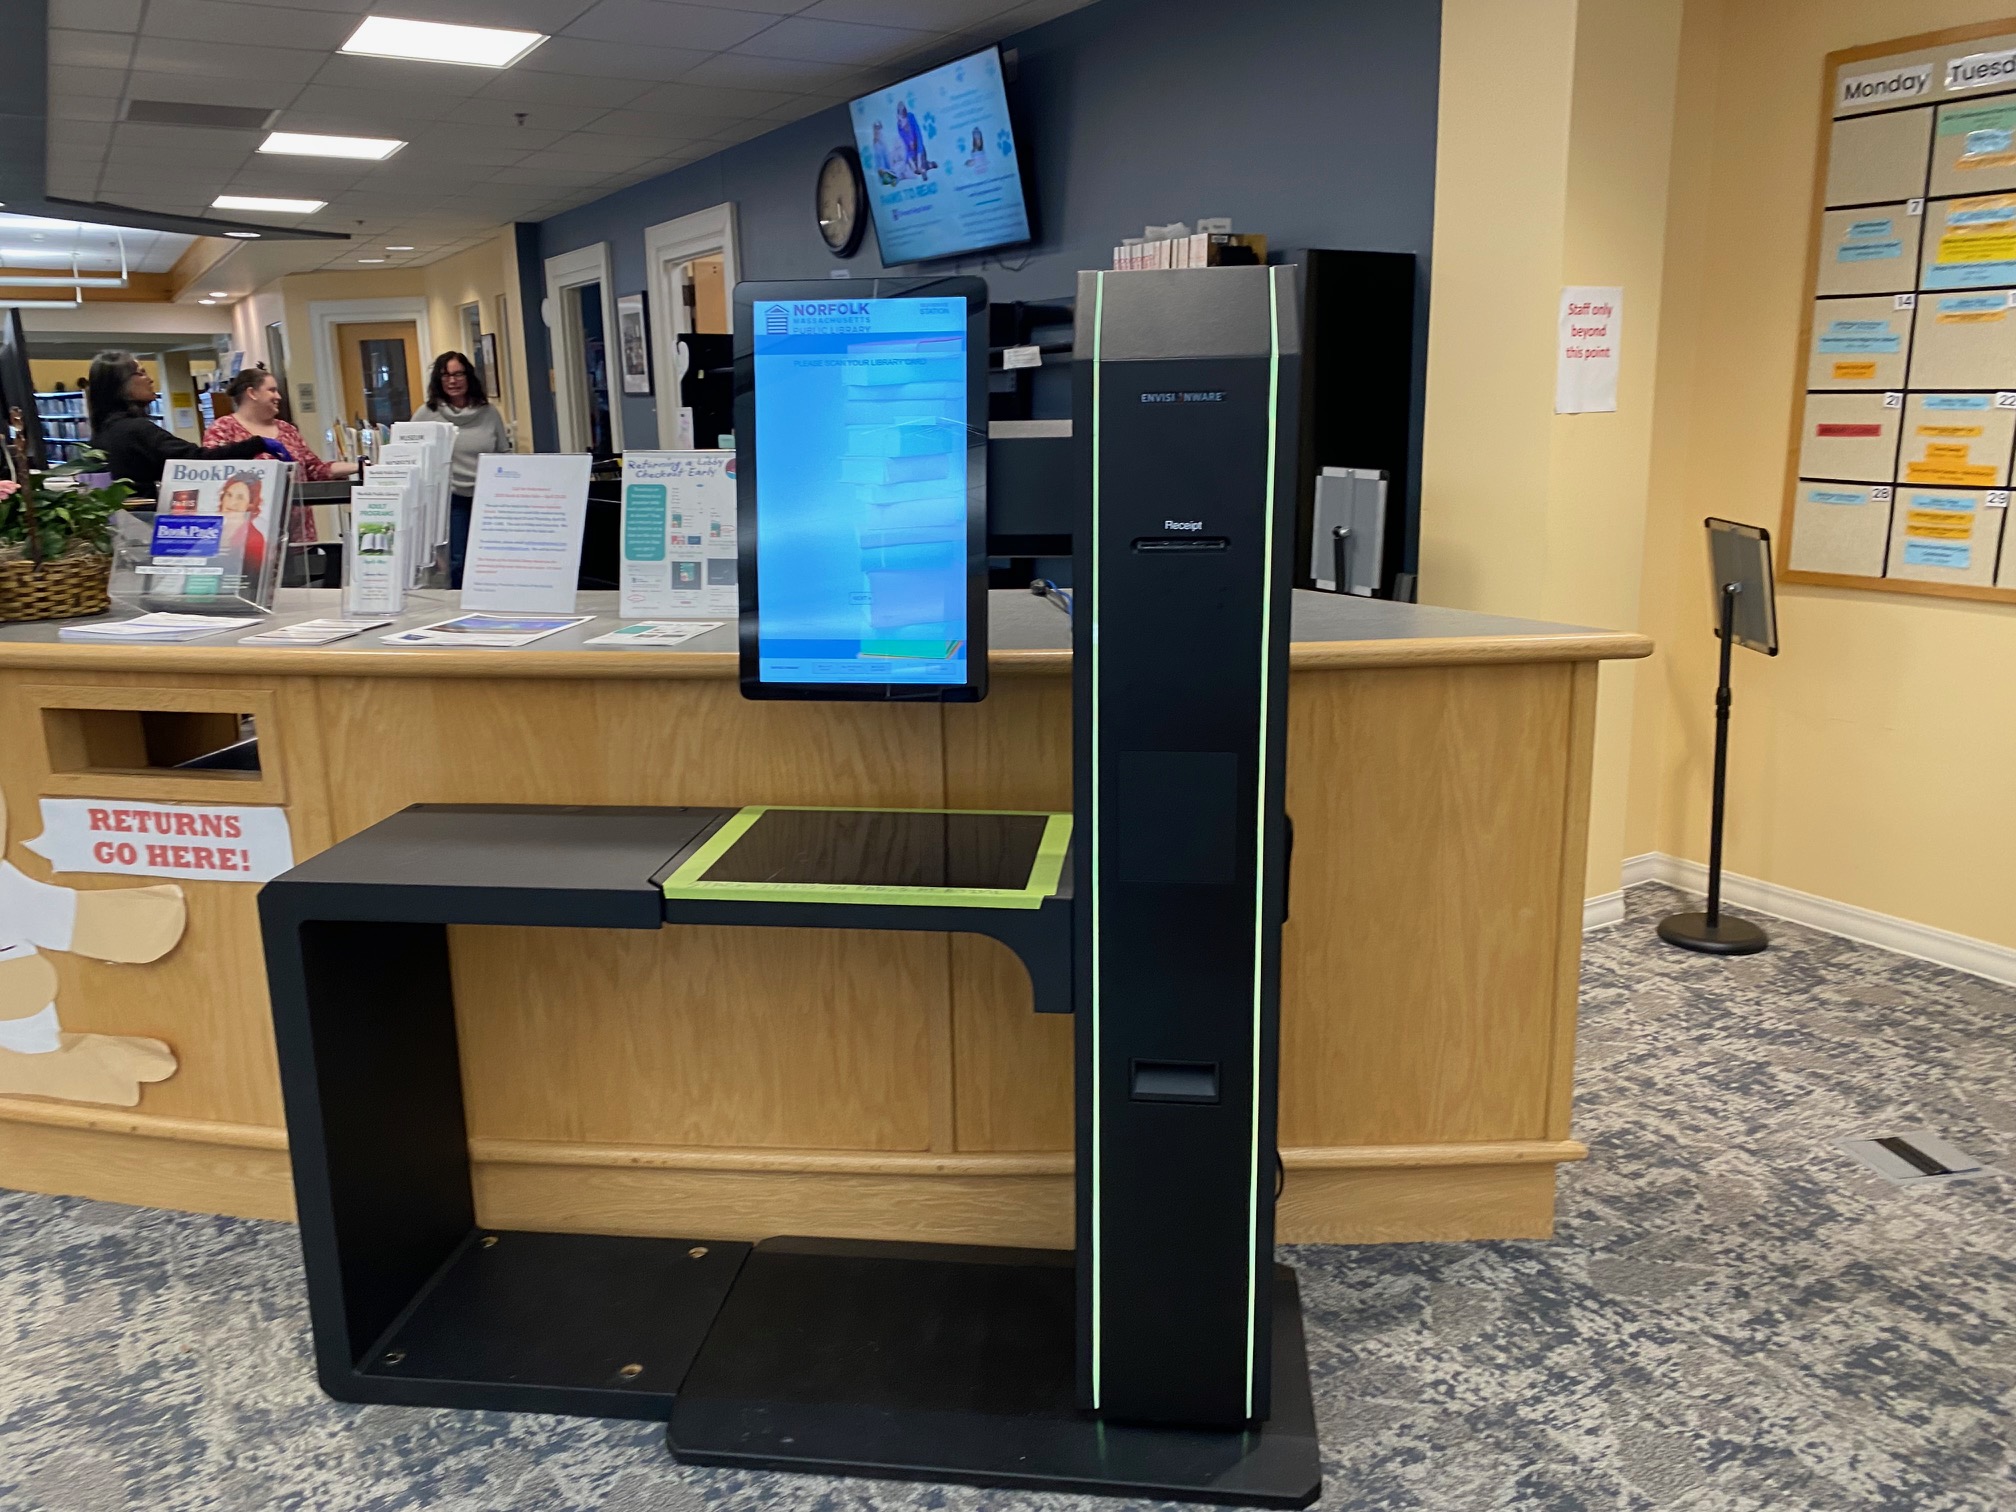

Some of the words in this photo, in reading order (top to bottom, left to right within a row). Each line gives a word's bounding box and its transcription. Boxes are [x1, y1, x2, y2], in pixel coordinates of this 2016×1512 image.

[1951, 54, 2016, 82] Tuesd
[1844, 73, 1930, 100] Monday
[1911, 201, 1920, 212] 7
[1898, 295, 1912, 307] 14
[794, 303, 870, 316] NORFOLK
[1568, 302, 1591, 315] Staff
[1592, 303, 1613, 318] only
[830, 326, 871, 334] LIBRARY
[1571, 324, 1607, 339] beyond
[1566, 347, 1583, 358] this
[1585, 346, 1610, 360] point
[871, 358, 903, 366] LIBRARY
[1886, 395, 1901, 406] 21
[1999, 394, 2016, 406] 22
[688, 467, 717, 477] Early
[1872, 488, 1889, 499] 28
[1164, 520, 1203, 531] Receipt
[88, 808, 242, 838] RETURNS
[93, 841, 137, 865] GO
[145, 844, 251, 872] HERE!
